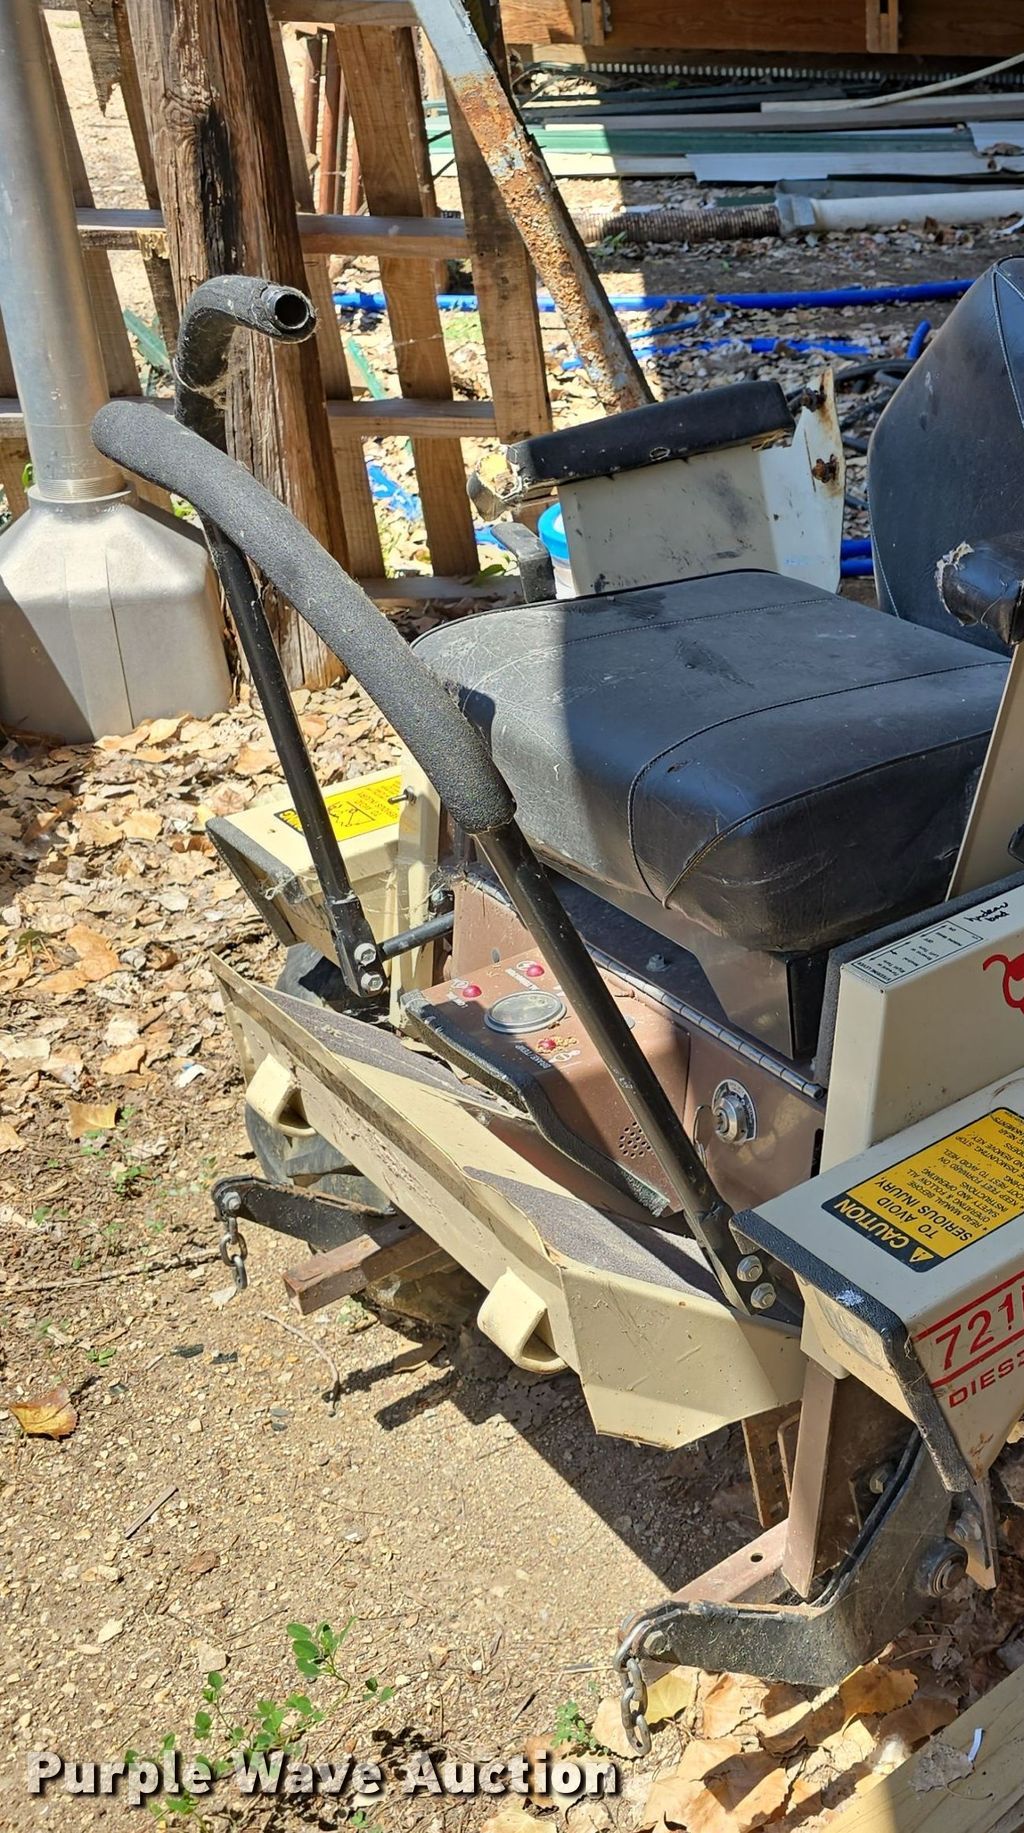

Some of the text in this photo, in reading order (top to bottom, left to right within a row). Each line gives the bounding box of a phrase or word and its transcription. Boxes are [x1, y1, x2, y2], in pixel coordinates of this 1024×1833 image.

[953, 1134, 975, 1147] STOP
[996, 1127, 1019, 1141] NEAR
[940, 1147, 962, 1161] HEEL
[983, 1142, 1015, 1161] REMOVE
[903, 1168, 921, 1179] ALL
[957, 1157, 981, 1172] AVOID
[976, 1169, 991, 1178] TO
[916, 1176, 948, 1196] FOLLOW
[936, 1155, 1020, 1206] KEEP FEET FORWARD ON
[987, 1176, 1010, 1190] REST
[919, 1167, 1001, 1218] SAFETY AND OPERATING
[905, 1179, 983, 1229] READ MANUAL BEFORE
[950, 1197, 992, 1223] OPERATING
[831, 1197, 913, 1251] CAUTION
[873, 1195, 941, 1239] TO AVOID
[914, 1203, 975, 1242] SERIOUS
